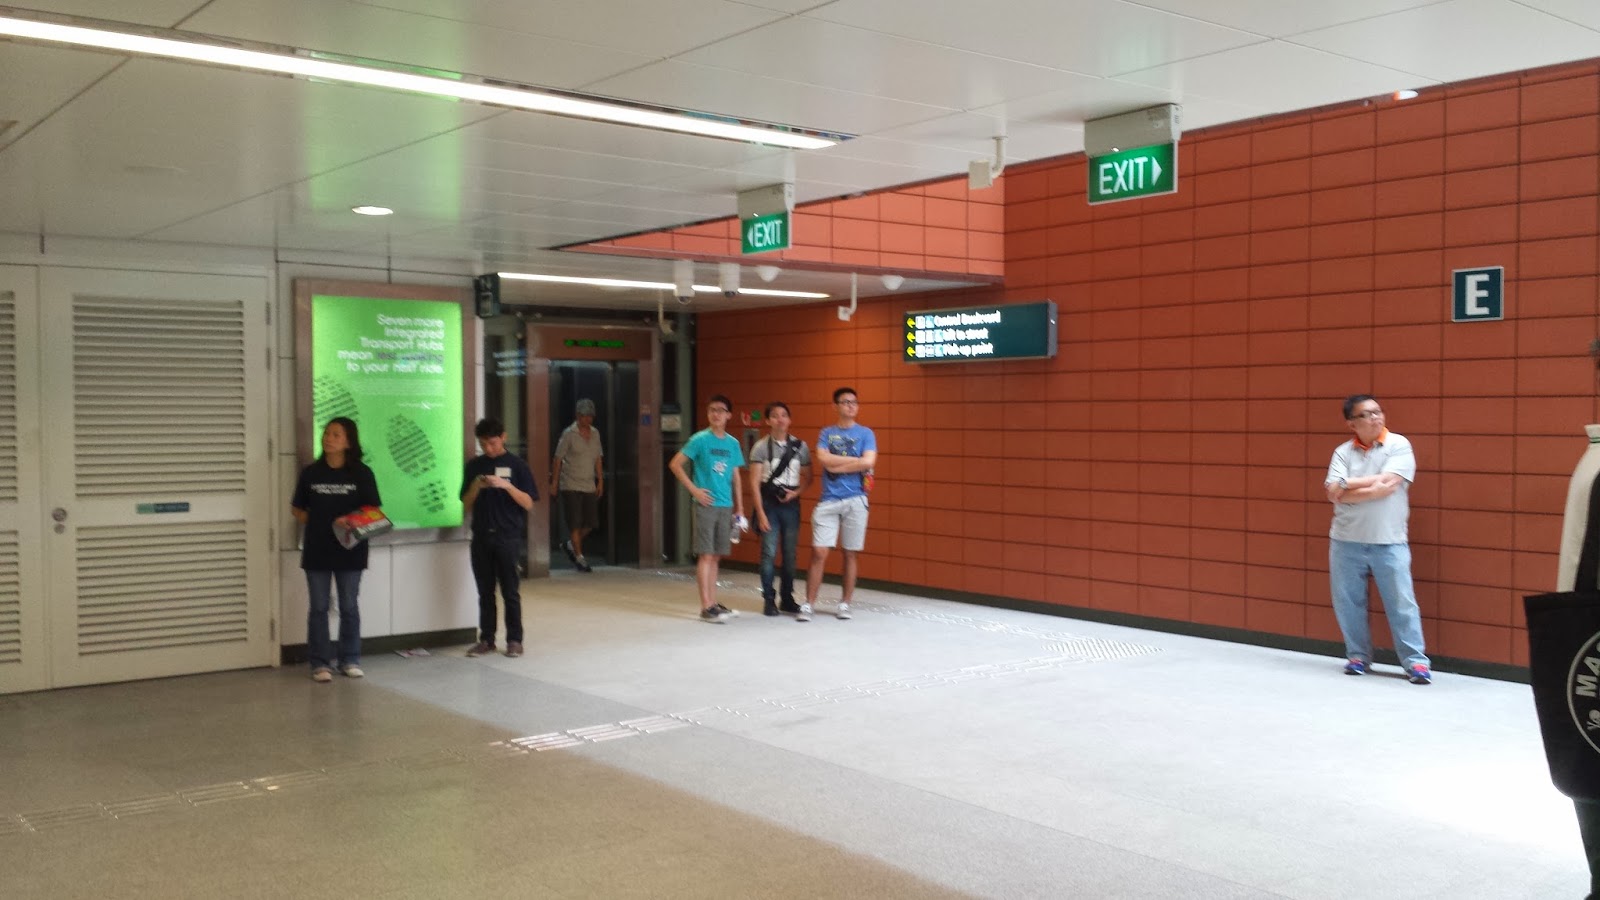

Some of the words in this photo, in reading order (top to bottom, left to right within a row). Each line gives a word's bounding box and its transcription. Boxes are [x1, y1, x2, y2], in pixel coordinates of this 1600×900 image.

[1099, 156, 1149, 195] EXIT
[754, 219, 783, 248] EXIT
[1465, 273, 1490, 316] E
[377, 313, 412, 326] Seven
[413, 317, 445, 328] more
[384, 327, 445, 340] Integrated
[360, 336, 414, 350] Transport
[337, 350, 374, 361] mean
[361, 363, 389, 375] your
[1575, 641, 1600, 698] MA
